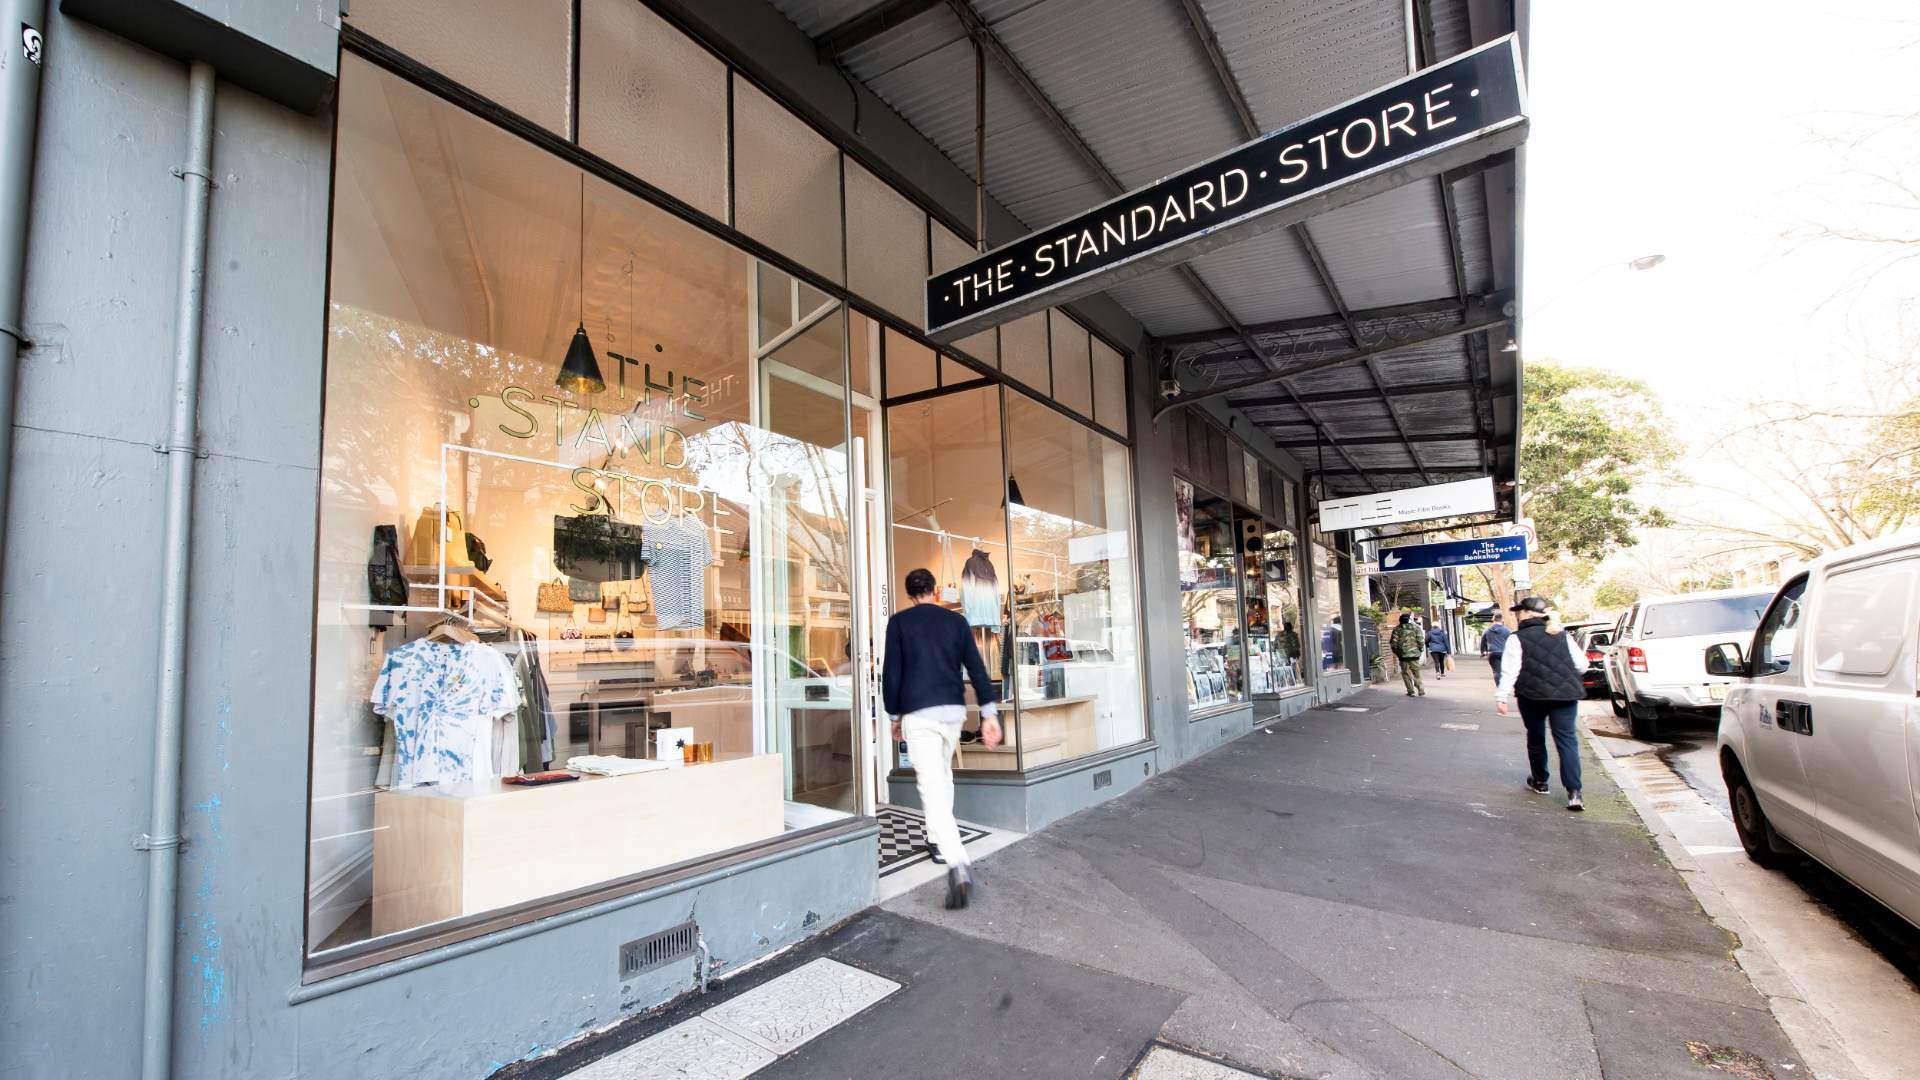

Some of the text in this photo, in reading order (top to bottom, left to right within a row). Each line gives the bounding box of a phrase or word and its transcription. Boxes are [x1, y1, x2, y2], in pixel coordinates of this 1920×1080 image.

[953, 83, 1457, 307] THE STANDARD STORE
[607, 351, 705, 421] THE
[569, 466, 735, 535] STORE
[1464, 552, 1501, 560] Bookshop
[1472, 545, 1521, 555] Architect's
